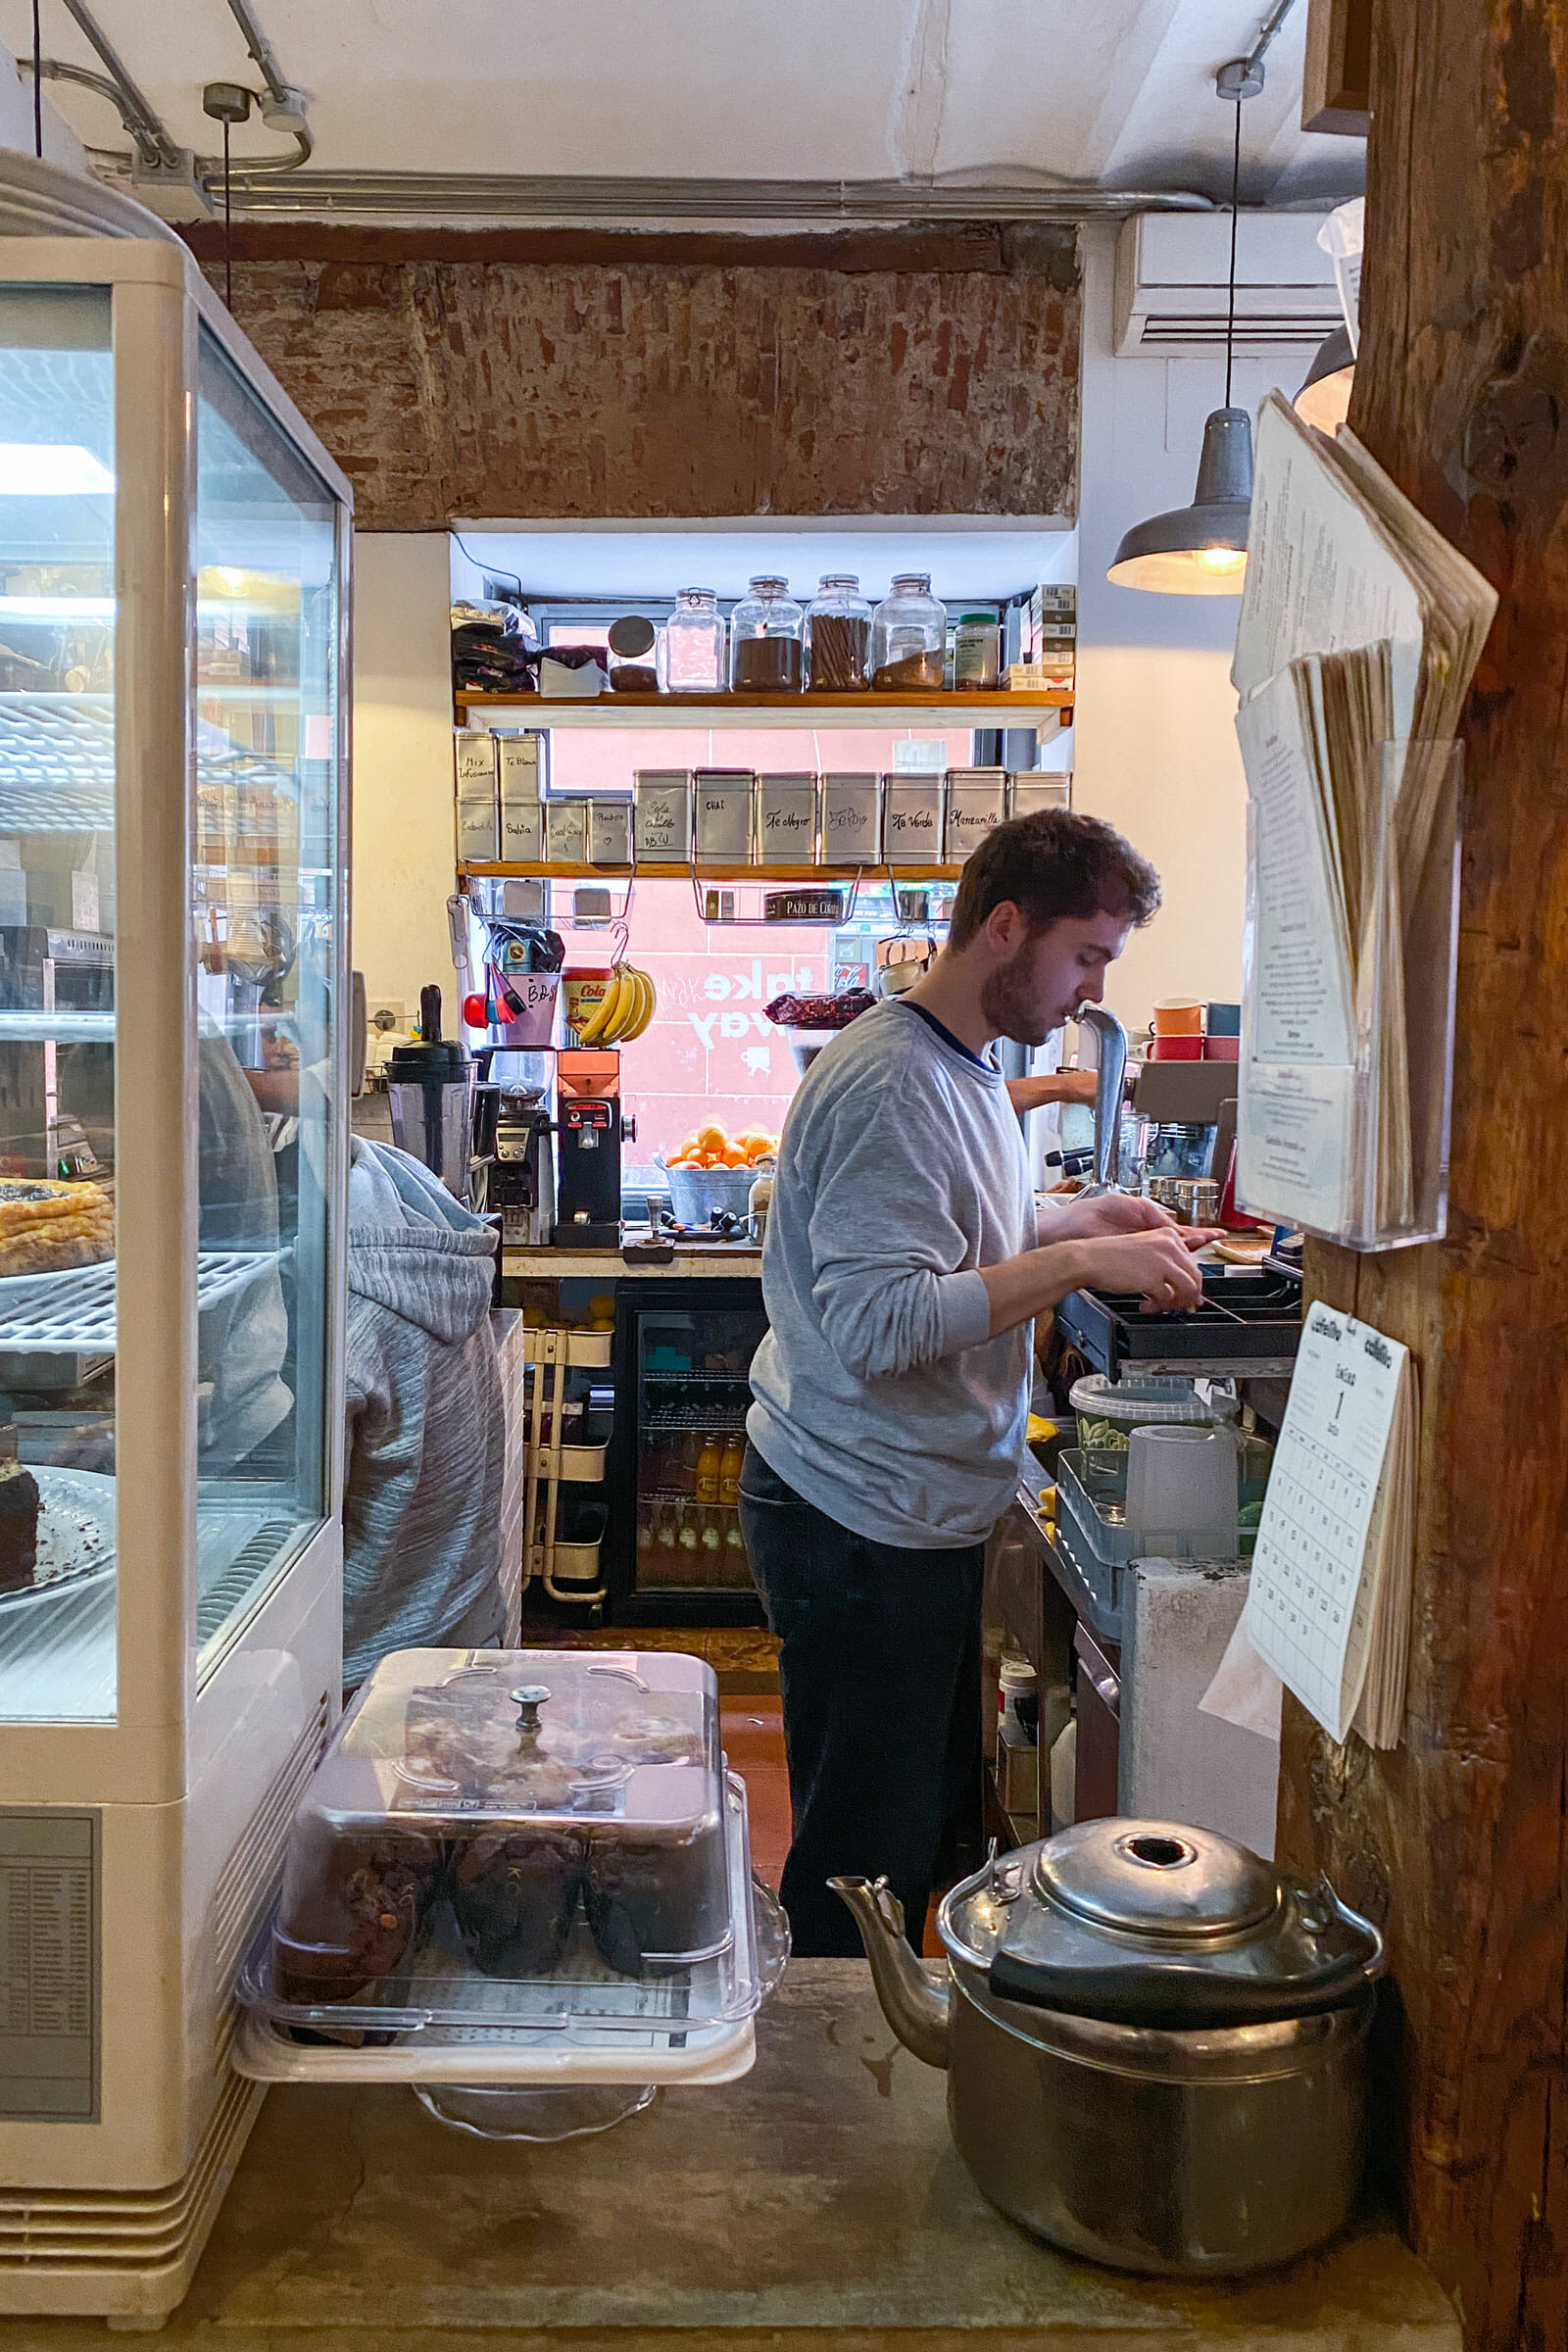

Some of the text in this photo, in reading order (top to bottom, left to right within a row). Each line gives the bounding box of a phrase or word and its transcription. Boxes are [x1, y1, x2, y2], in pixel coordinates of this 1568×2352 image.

[466, 758, 484, 766] Mix
[783, 812, 810, 830] Negro
[908, 810, 933, 827] Verde
[950, 809, 1002, 827] Manzanilla
[506, 823, 531, 835] Salvia
[808, 902, 817, 914] DE
[580, 984, 606, 997] Cola
